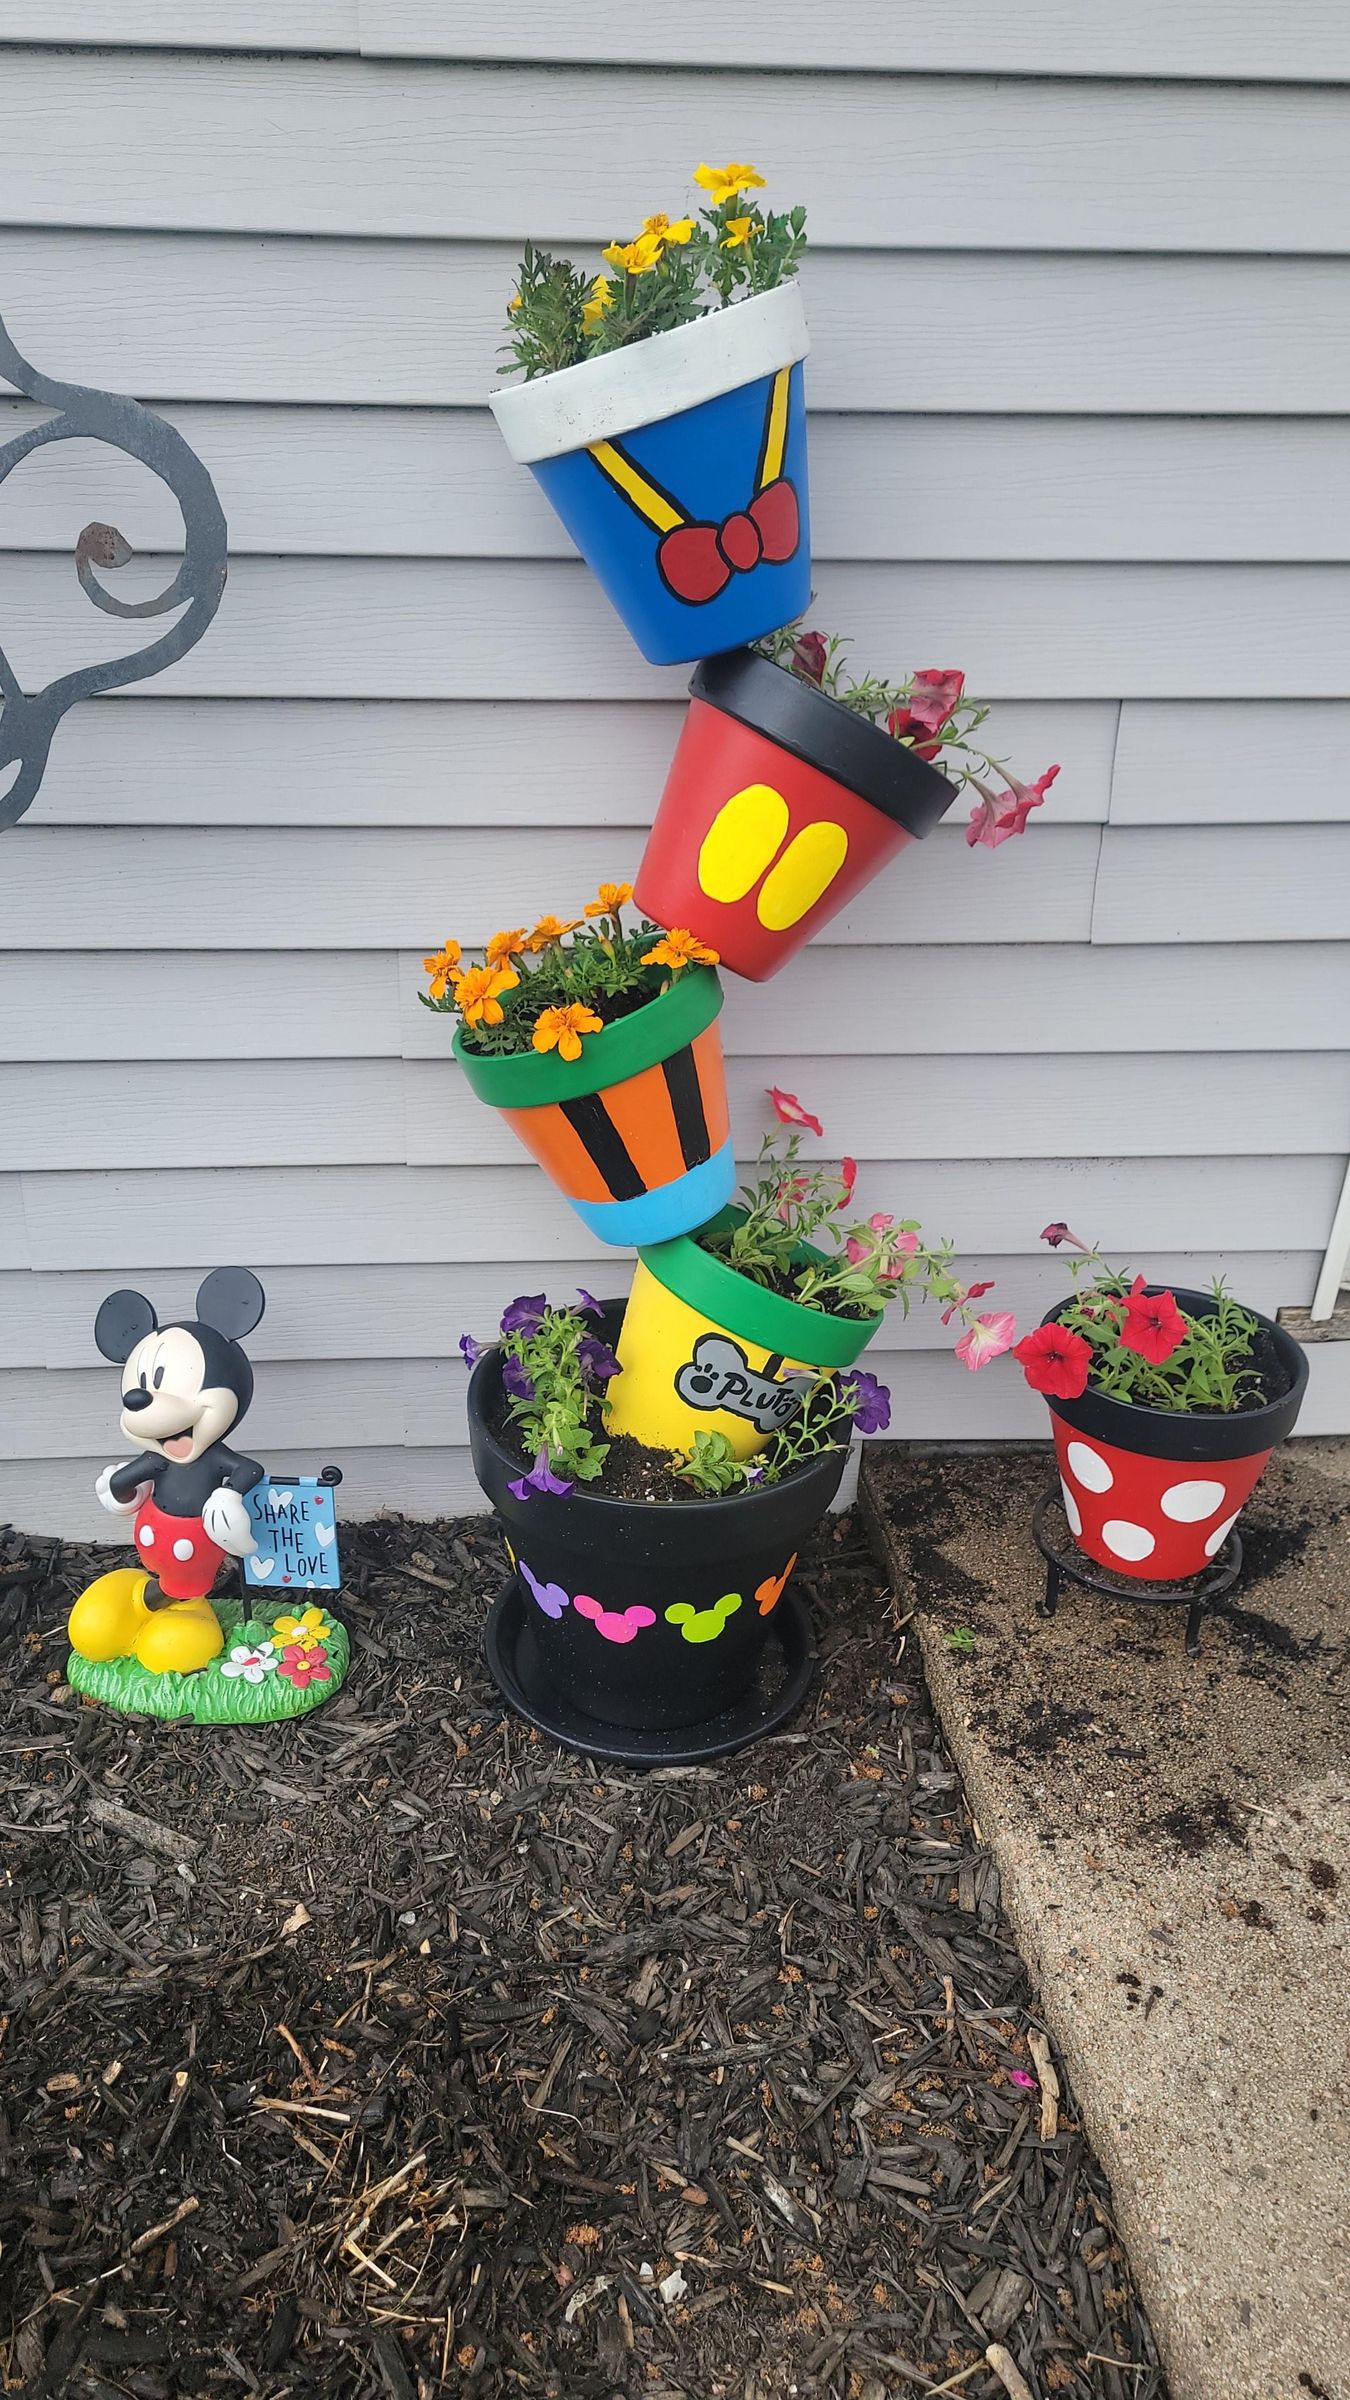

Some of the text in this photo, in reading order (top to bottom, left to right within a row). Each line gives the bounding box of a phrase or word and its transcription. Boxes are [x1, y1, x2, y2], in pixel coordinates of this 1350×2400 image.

[716, 1372, 794, 1417] PLUTO
[253, 1494, 310, 1525] SHARE
[268, 1526, 304, 1554] THE
[285, 1552, 328, 1577] LOVE
